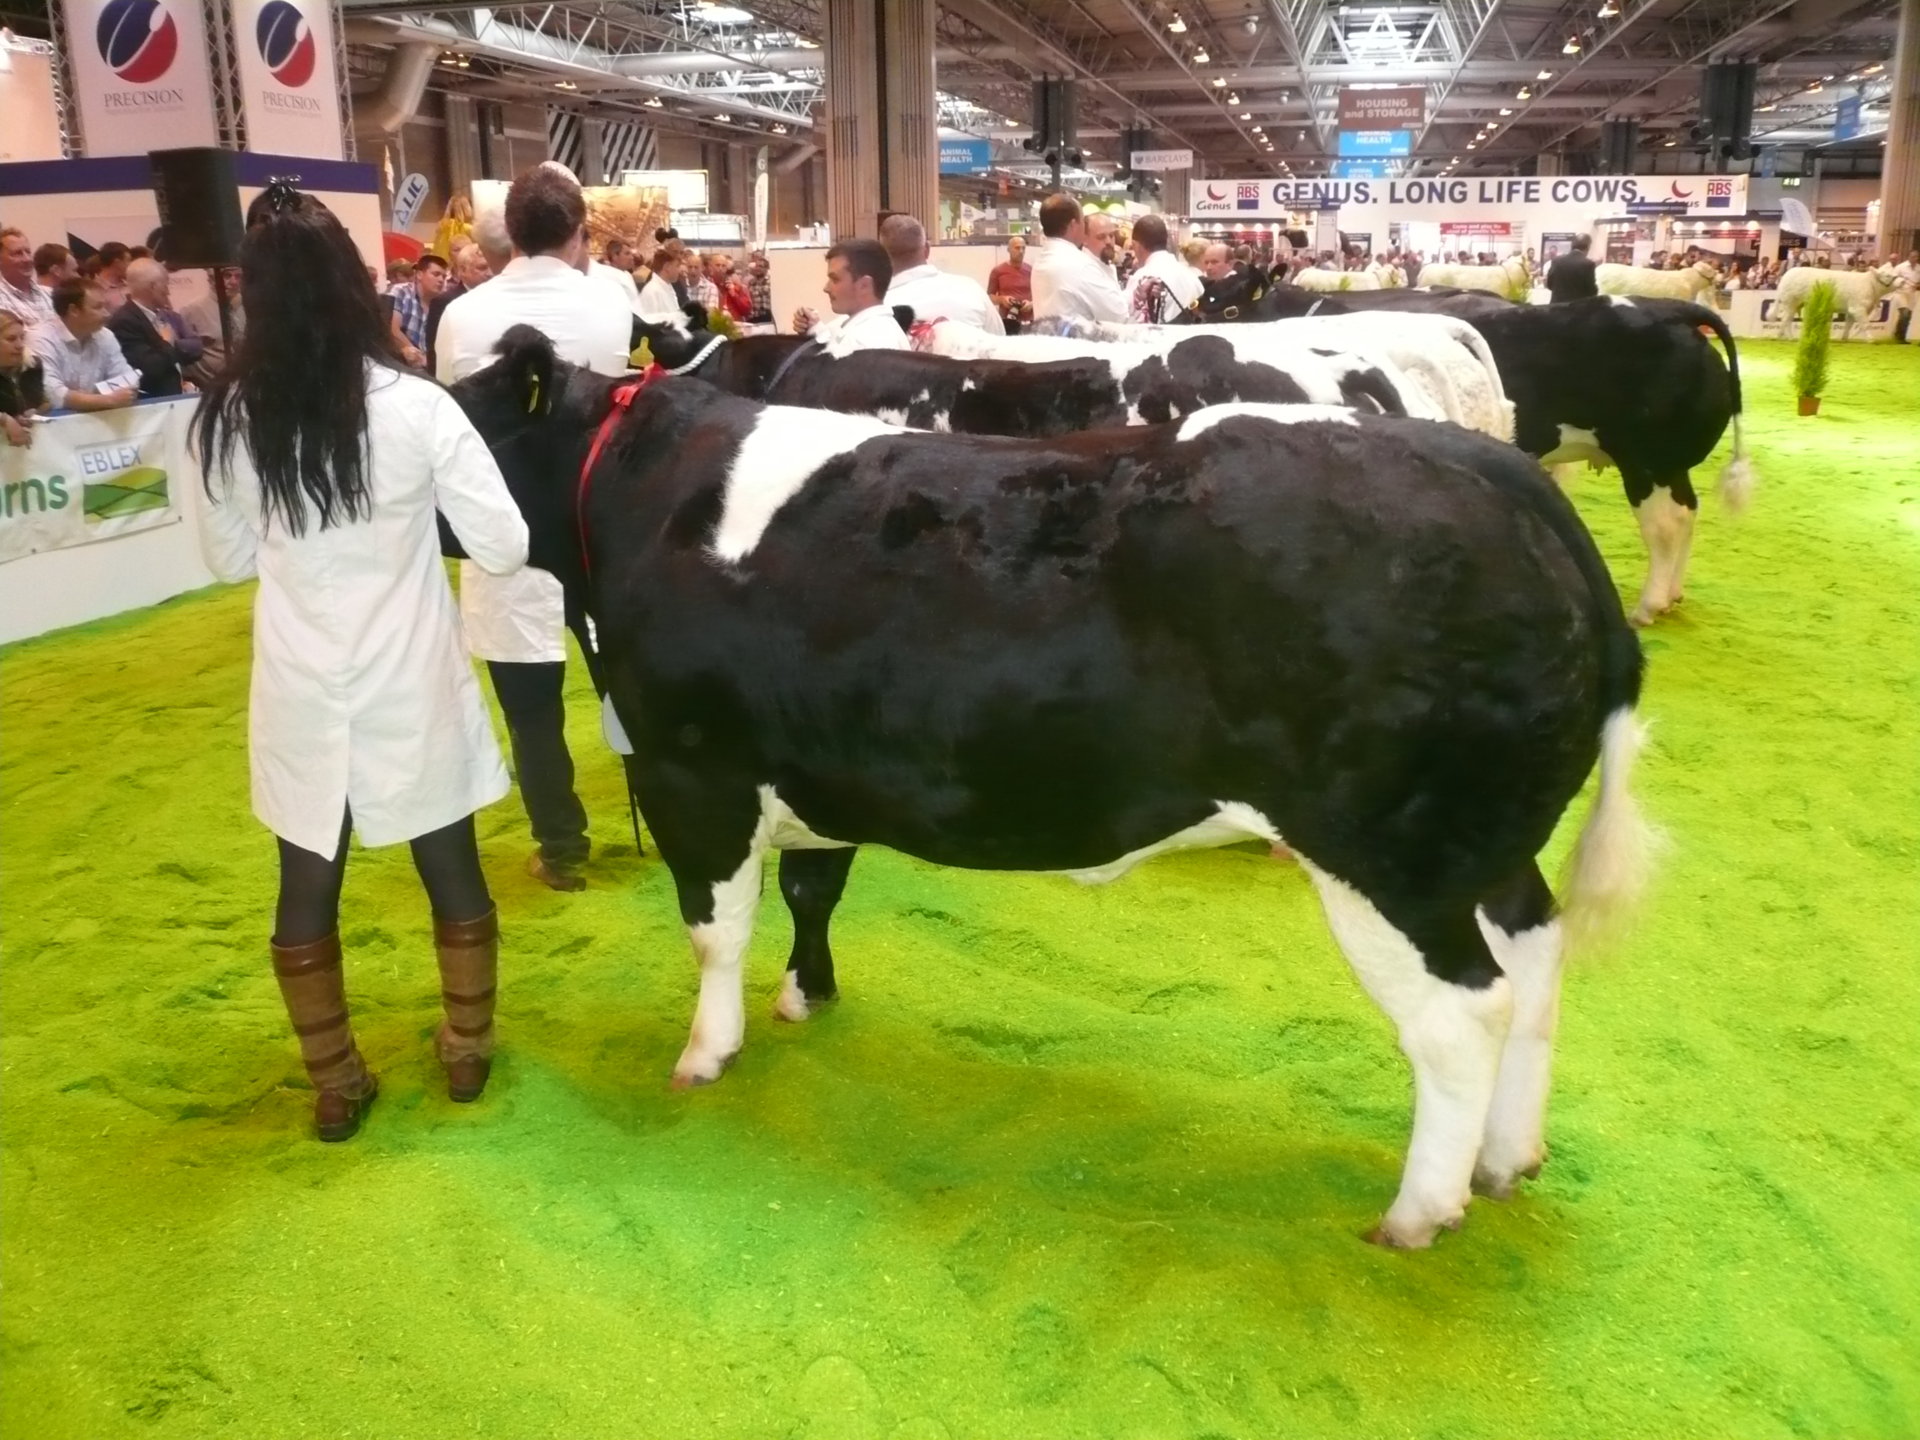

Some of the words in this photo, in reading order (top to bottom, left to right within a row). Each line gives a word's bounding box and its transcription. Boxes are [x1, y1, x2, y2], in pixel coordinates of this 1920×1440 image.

[103, 89, 184, 107] PRECISION
[262, 91, 320, 111] PRECISION
[1356, 98, 1408, 108] HOUSING
[1344, 110, 1364, 118] and
[1367, 108, 1419, 118] STORAGE
[940, 148, 972, 156] ANIMAL
[1145, 154, 1189, 163] BARCLAYS
[403, 176, 424, 209] LIC
[1237, 185, 1259, 198] ABS
[1273, 182, 1377, 204] GENUS.
[1389, 181, 1467, 204] LONG
[1478, 181, 1541, 203] LIFE
[1707, 182, 1732, 196] ABS
[1196, 200, 1231, 210] Genus
[81, 445, 142, 475] EBLEX
[0, 475, 69, 518] rns
